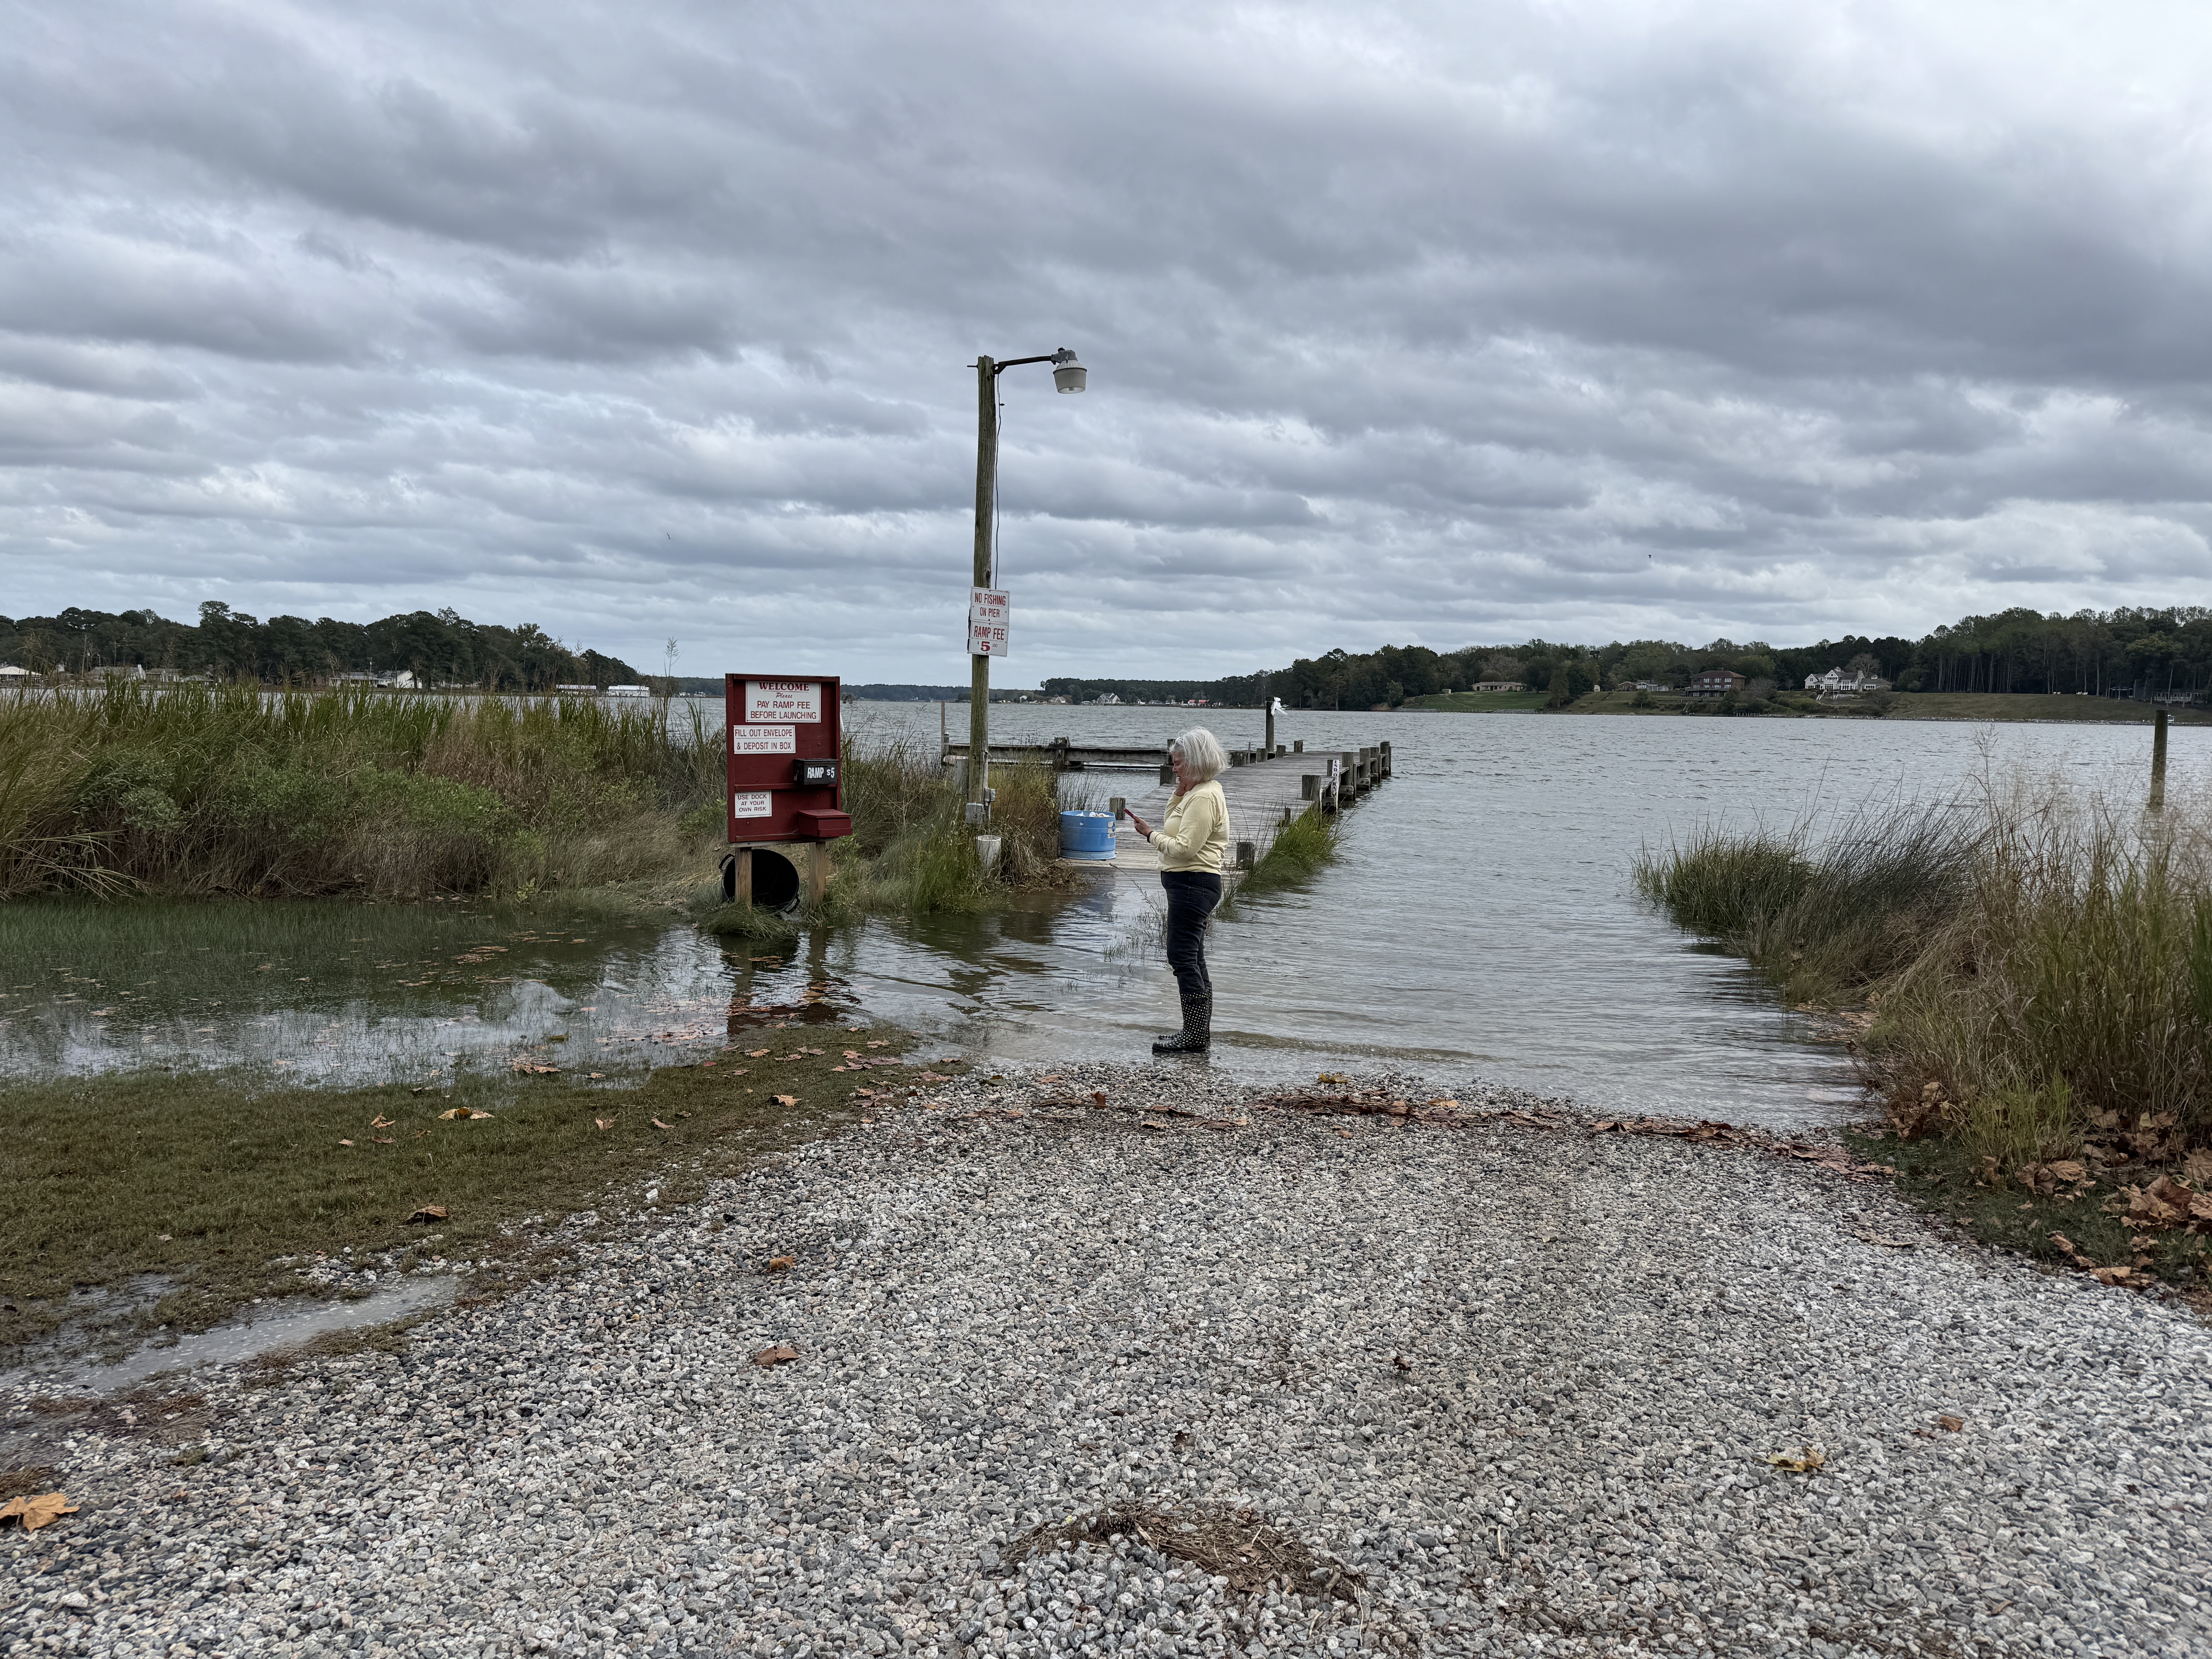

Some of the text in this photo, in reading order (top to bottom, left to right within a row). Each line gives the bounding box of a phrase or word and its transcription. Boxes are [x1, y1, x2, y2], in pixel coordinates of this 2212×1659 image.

[975, 592, 1006, 606] NO FISHING
[980, 607, 1000, 618] ON PIER
[974, 626, 1005, 641] RAMP FEE
[759, 682, 809, 691] WELCOME
[749, 729, 761, 737] OUT
[807, 767, 835, 778] RAMP $5
